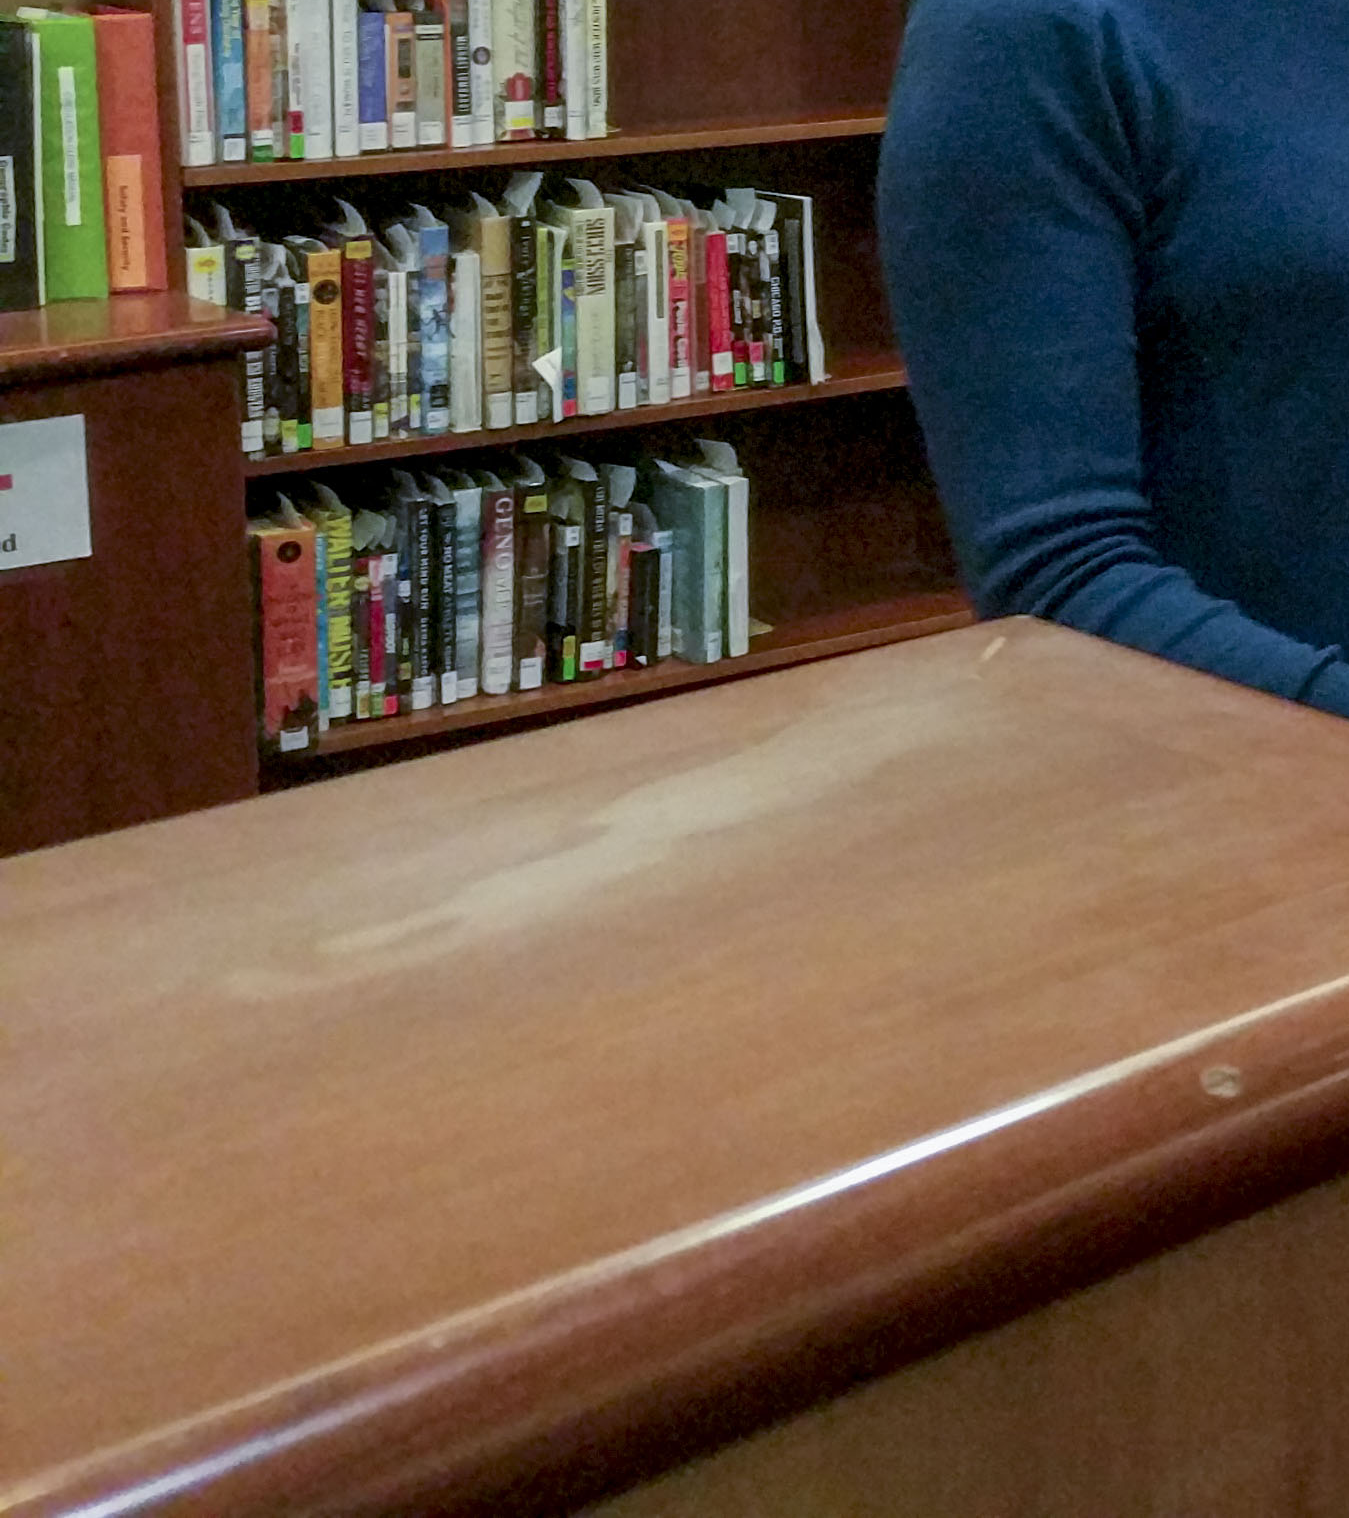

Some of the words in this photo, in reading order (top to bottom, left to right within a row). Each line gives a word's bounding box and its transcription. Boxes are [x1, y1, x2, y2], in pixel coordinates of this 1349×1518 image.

[120, 216, 130, 233] and
[770, 277, 782, 317] CHICAGO
[420, 529, 429, 555] YOUR
[420, 558, 430, 585] MIND
[443, 565, 454, 593] MEAT
[420, 648, 429, 676] KASTO
